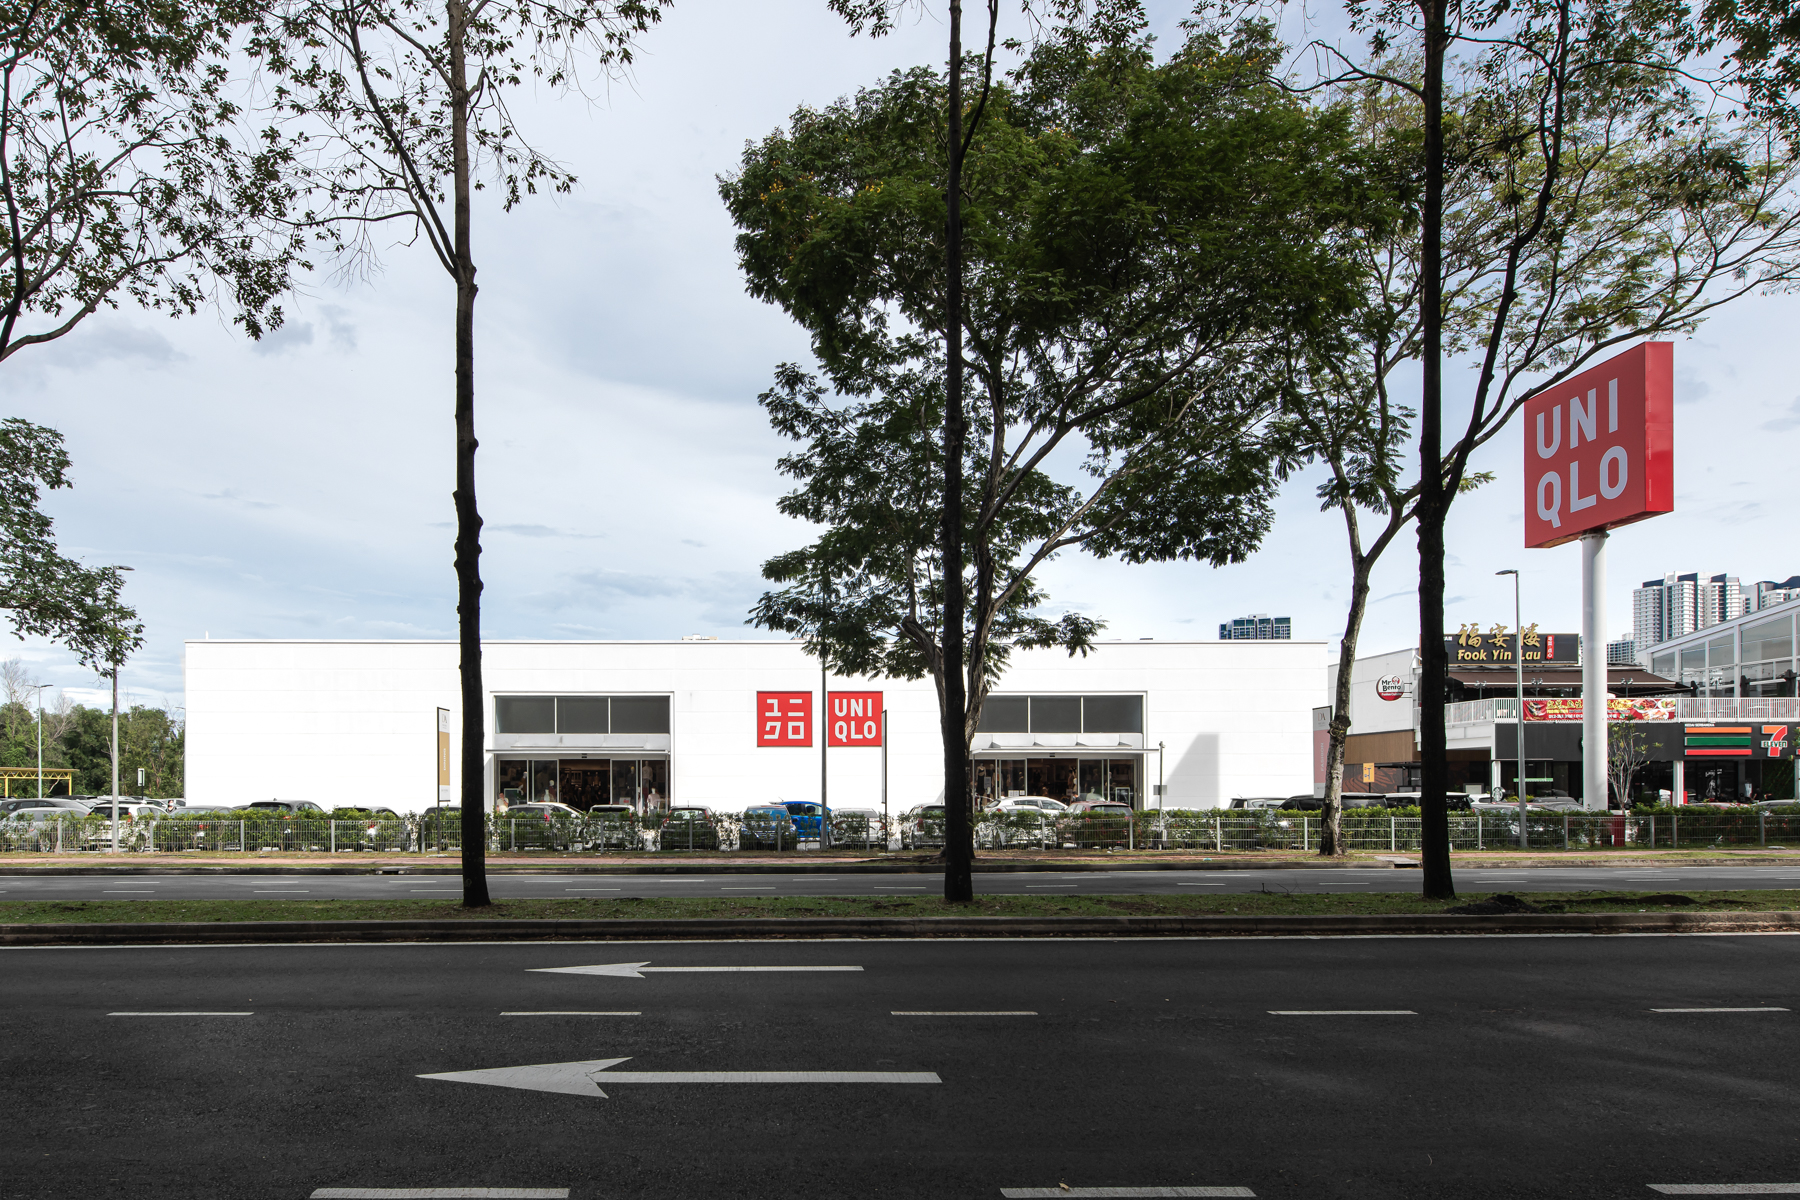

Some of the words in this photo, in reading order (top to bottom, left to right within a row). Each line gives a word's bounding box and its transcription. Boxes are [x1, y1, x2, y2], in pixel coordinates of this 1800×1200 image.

[1536, 377, 1619, 460] UNI
[1537, 445, 1629, 529] QLO
[1457, 649, 1487, 661] Fook
[1492, 649, 1512, 661] Yin
[1520, 649, 1541, 661] Lau
[834, 698, 873, 717] UNI
[834, 720, 877, 742] QLO
[1761, 724, 1788, 757] 7
